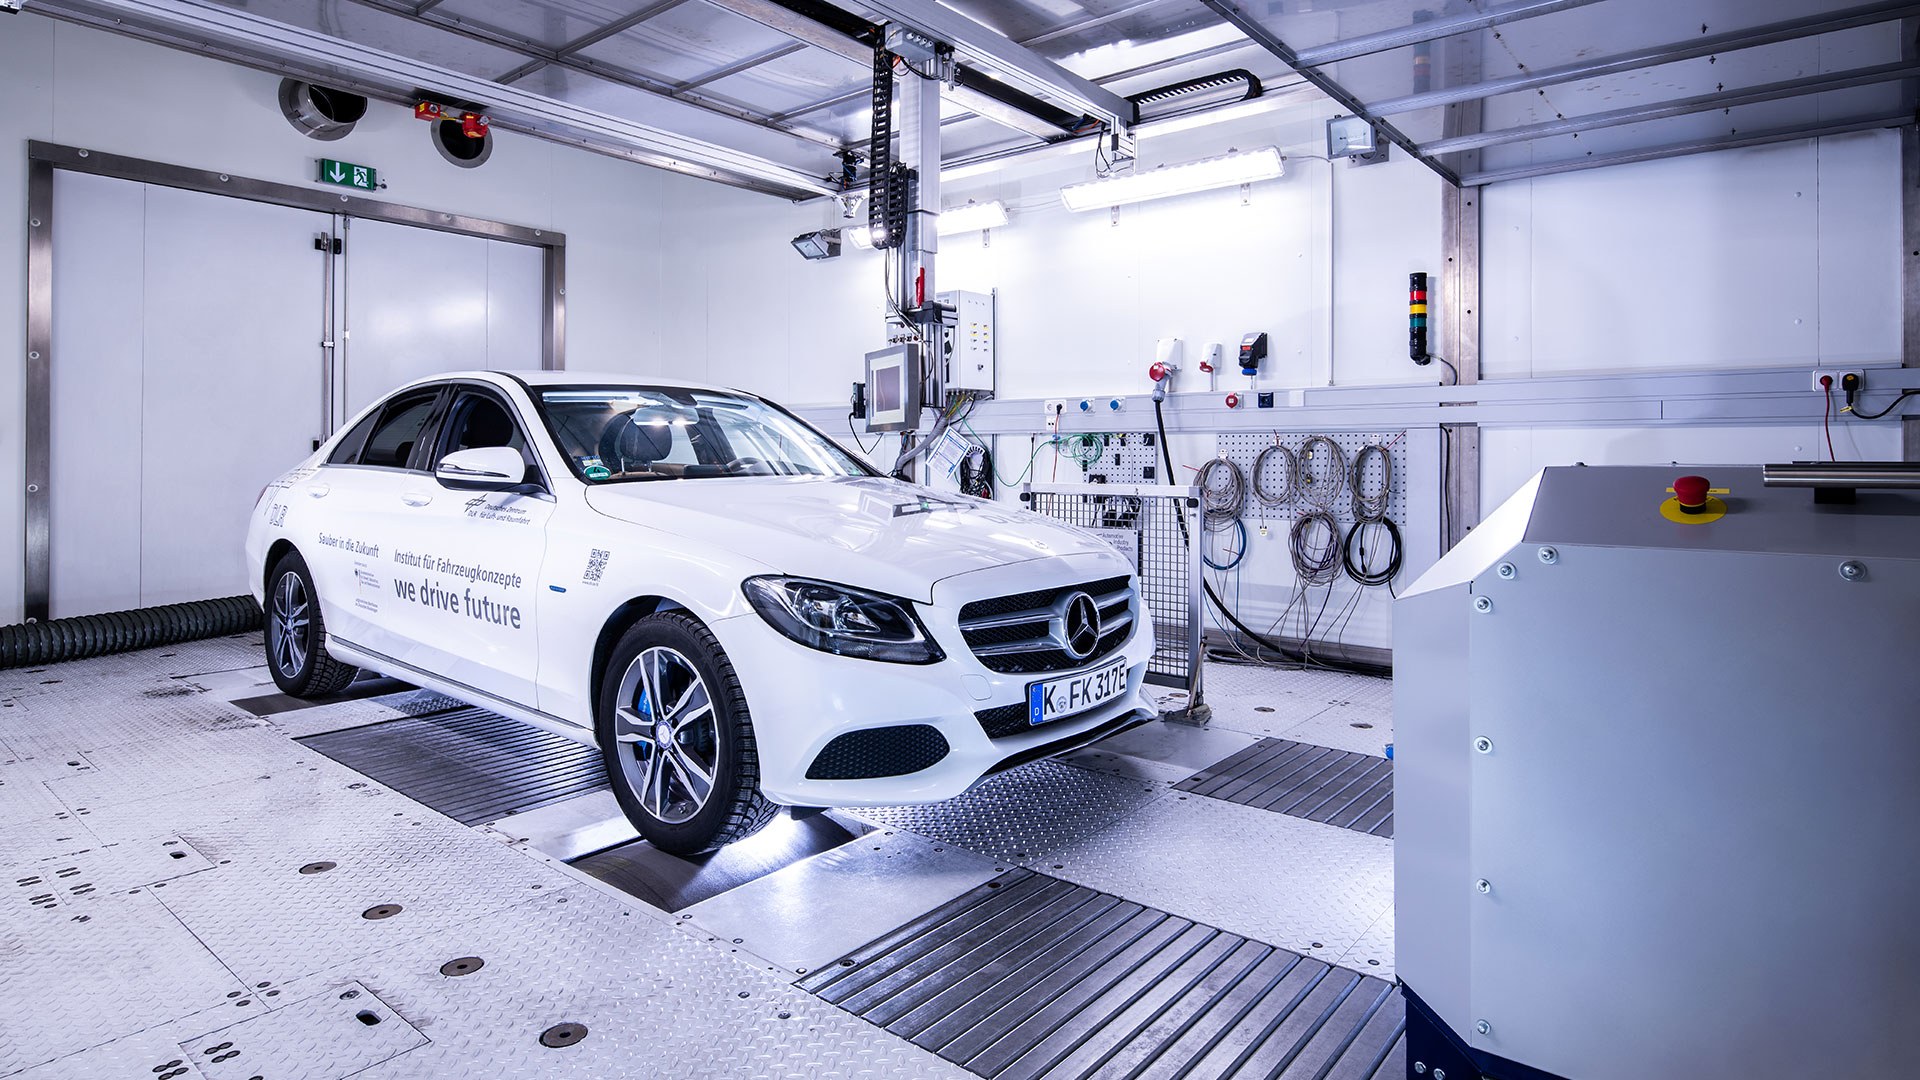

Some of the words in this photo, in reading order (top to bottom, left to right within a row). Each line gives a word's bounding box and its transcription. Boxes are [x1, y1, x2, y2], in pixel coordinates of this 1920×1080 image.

[319, 532, 338, 548] Sauber
[339, 536, 345, 549] in
[345, 538, 354, 552] die
[355, 541, 379, 558] Zukunft
[394, 549, 421, 568] Institut
[423, 553, 435, 570] für
[437, 557, 522, 589] Fahrzeugkonzepte
[394, 578, 416, 602] we
[420, 578, 459, 614] drive
[464, 588, 521, 629] future
[1044, 685, 1056, 715] K
[1069, 676, 1092, 709] FK
[1095, 663, 1126, 701] 317E
[1034, 707, 1039, 716] D
